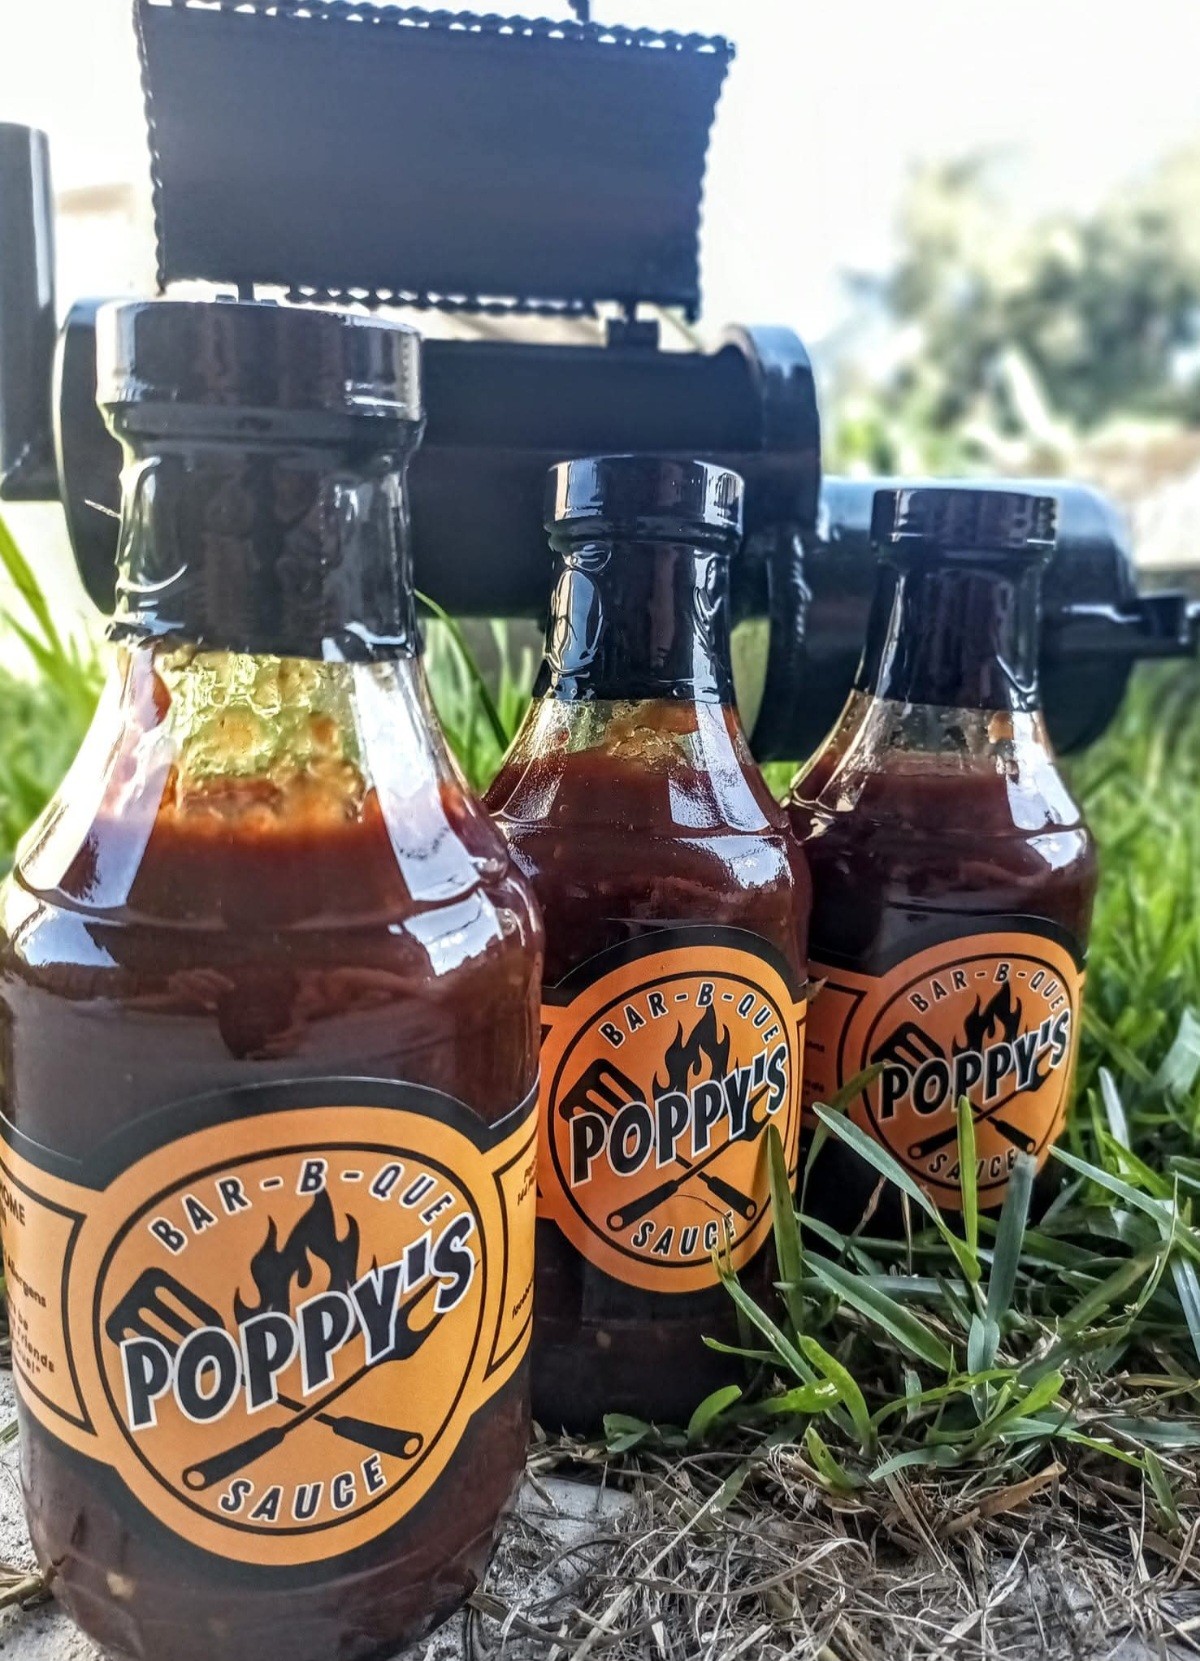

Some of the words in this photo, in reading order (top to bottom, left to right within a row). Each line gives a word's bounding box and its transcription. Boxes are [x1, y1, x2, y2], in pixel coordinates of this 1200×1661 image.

[598, 981, 781, 1049] BAR-B-QUE
[909, 962, 1065, 1014] BAR-B-QUE
[878, 1008, 1071, 1122] POPPY'S
[569, 1043, 787, 1188] POPPY'S
[148, 1158, 454, 1254] BAR-B-QUE
[118, 1211, 476, 1432] POPPY'S
[217, 1454, 388, 1522] SAUCE
